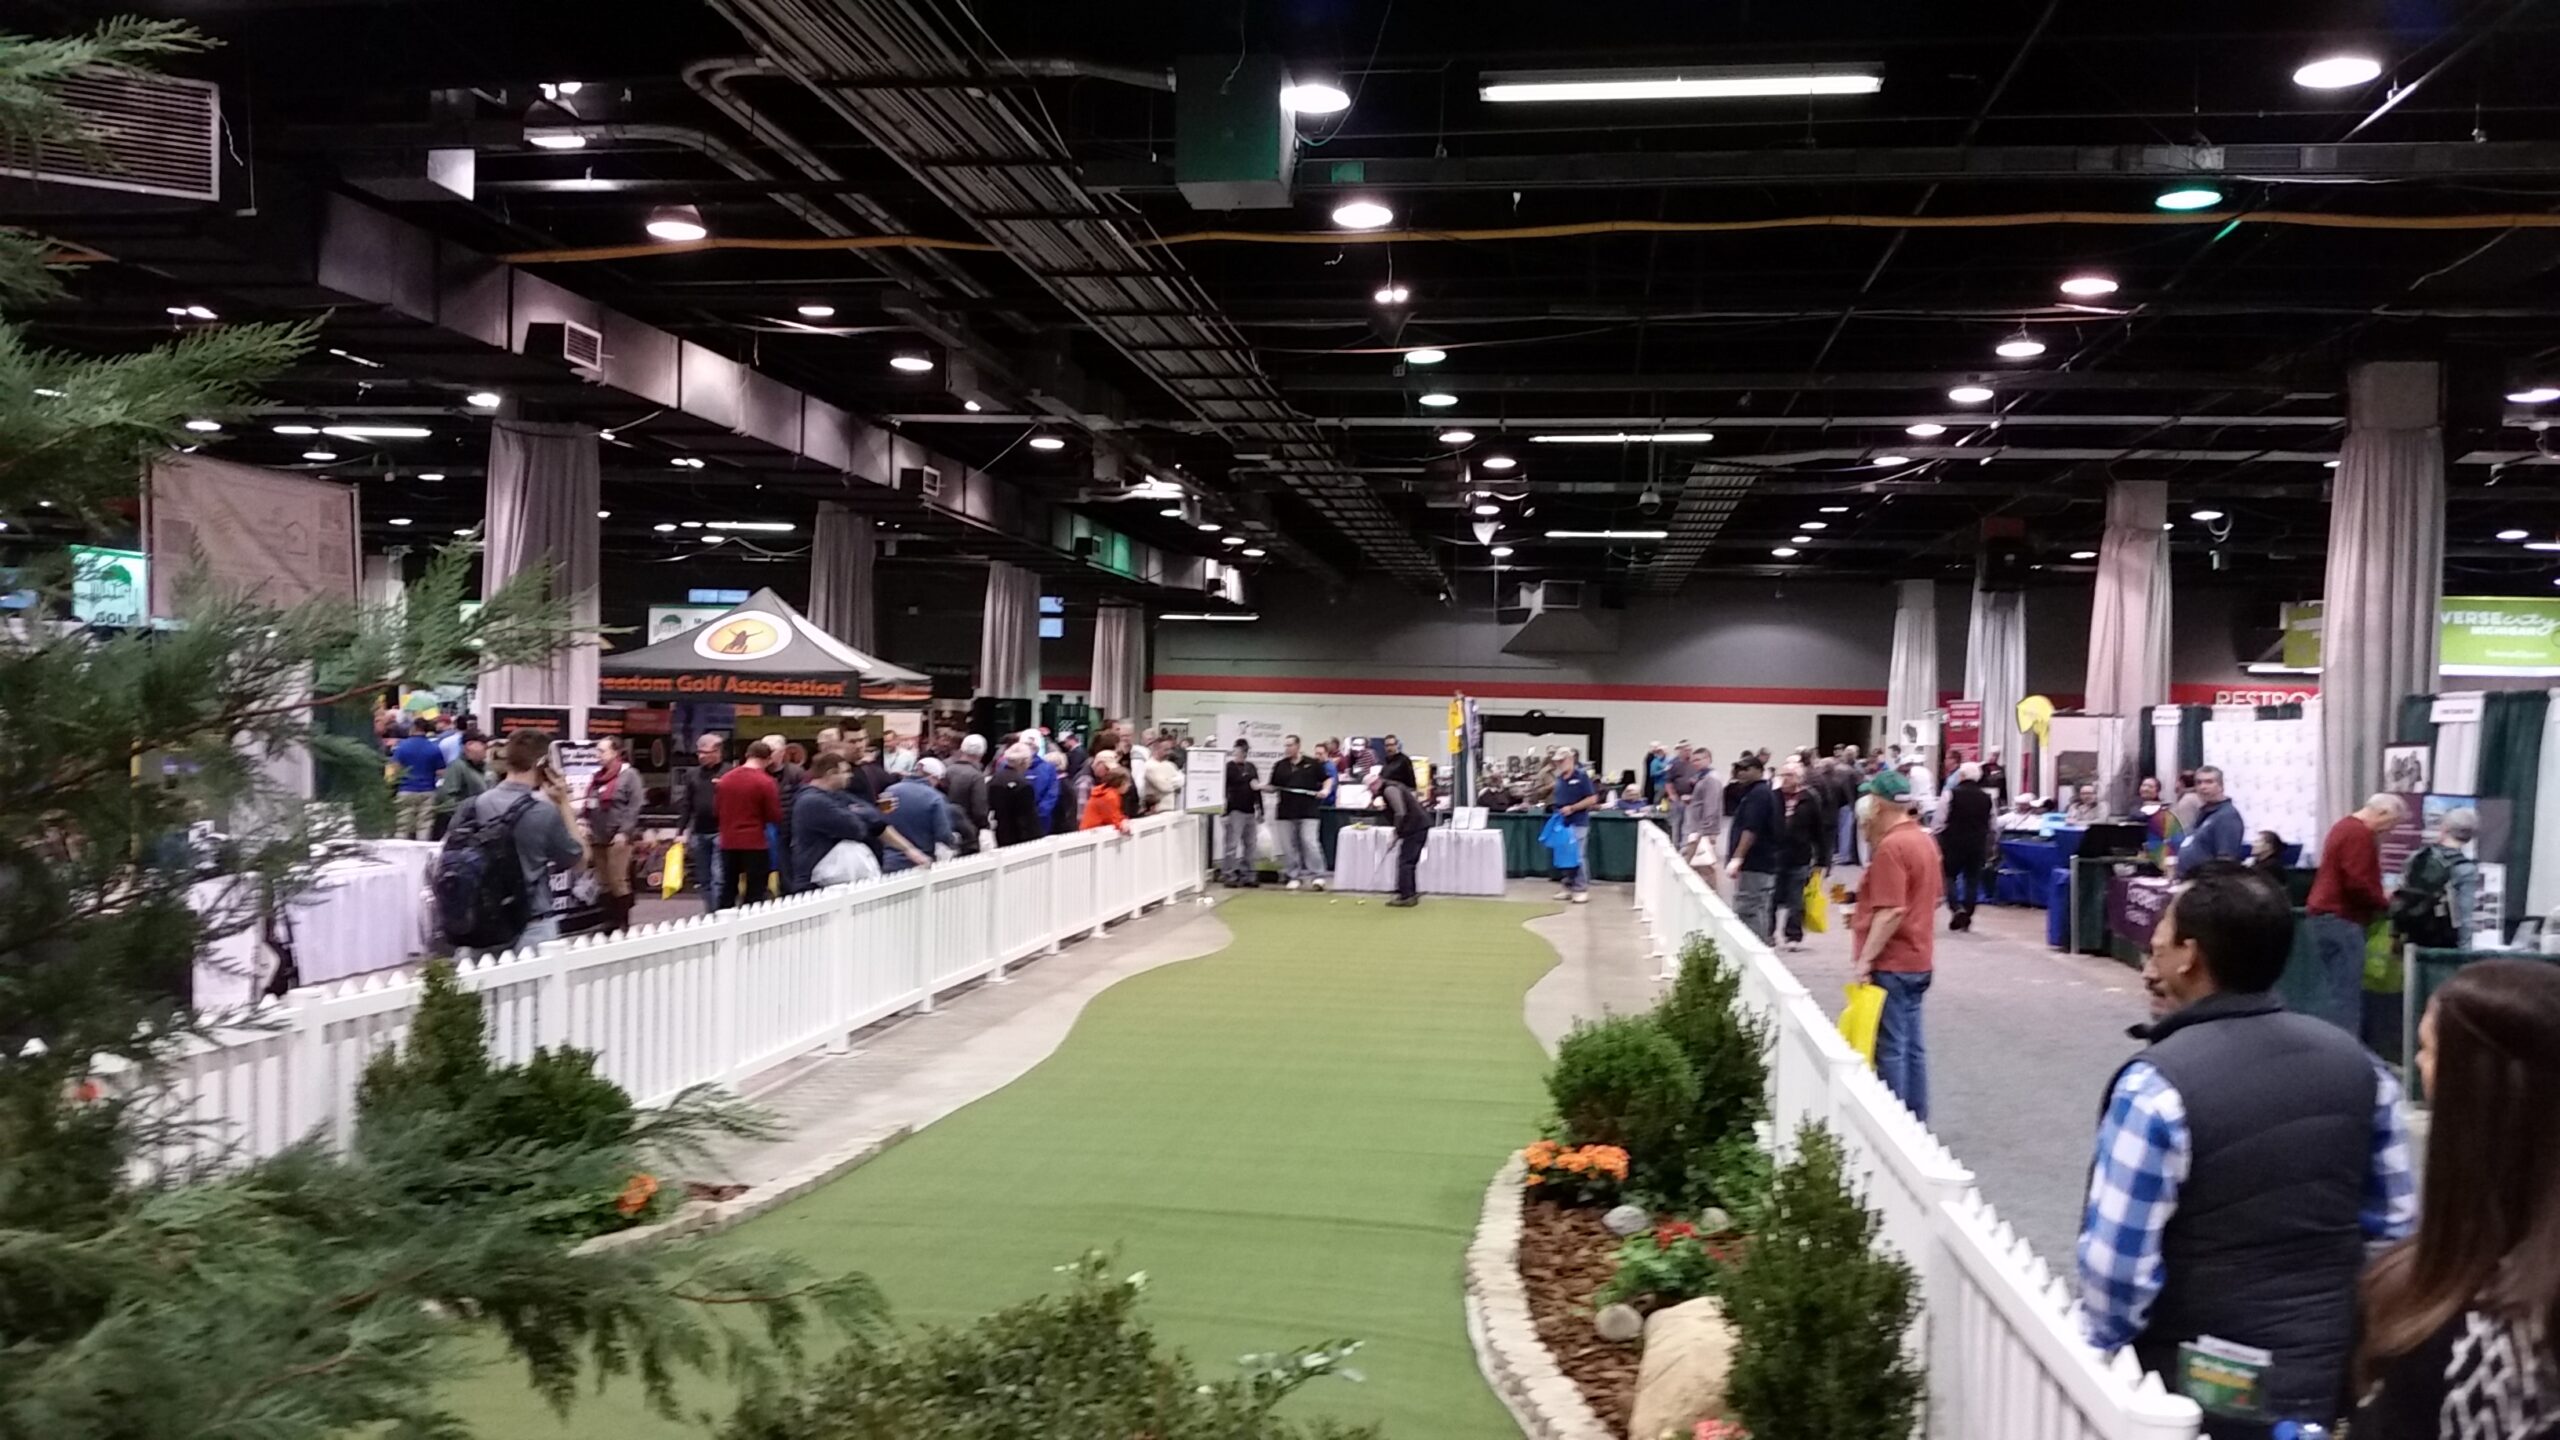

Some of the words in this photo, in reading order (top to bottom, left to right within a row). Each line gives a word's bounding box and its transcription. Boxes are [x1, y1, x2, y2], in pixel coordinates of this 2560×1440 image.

[2440, 611, 2503, 625] VERSE
[600, 675, 673, 692] eedom
[677, 675, 722, 693] Golf
[724, 675, 845, 697] Association
[2215, 690, 2321, 706] RESTRO
